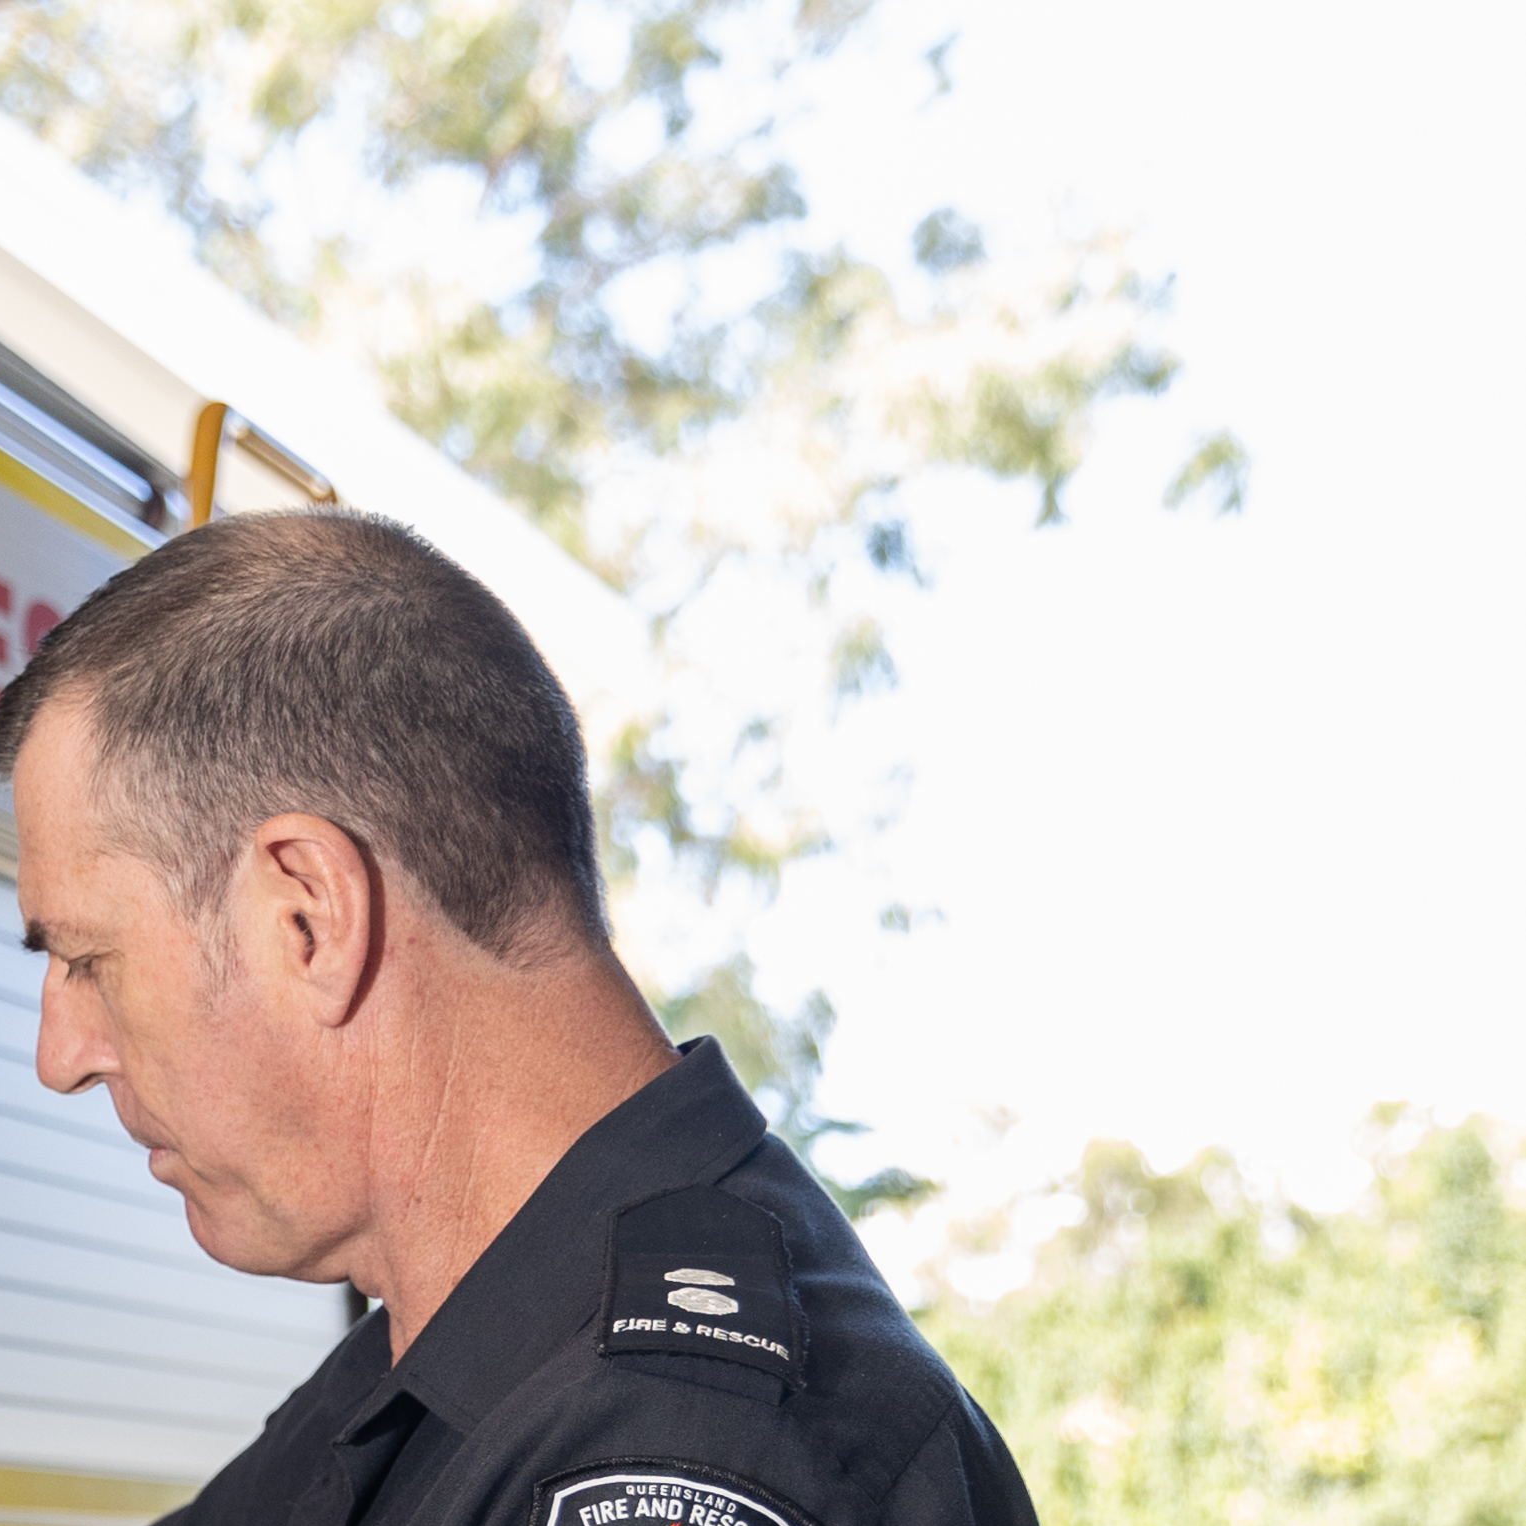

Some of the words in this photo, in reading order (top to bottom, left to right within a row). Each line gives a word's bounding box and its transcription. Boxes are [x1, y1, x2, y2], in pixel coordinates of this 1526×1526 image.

[612, 1317, 667, 1333] FIRE
[672, 1321, 692, 1334] &
[696, 1324, 790, 1361] RESCUE
[625, 1484, 738, 1514] QUEENSLAND
[634, 1497, 684, 1521] AND
